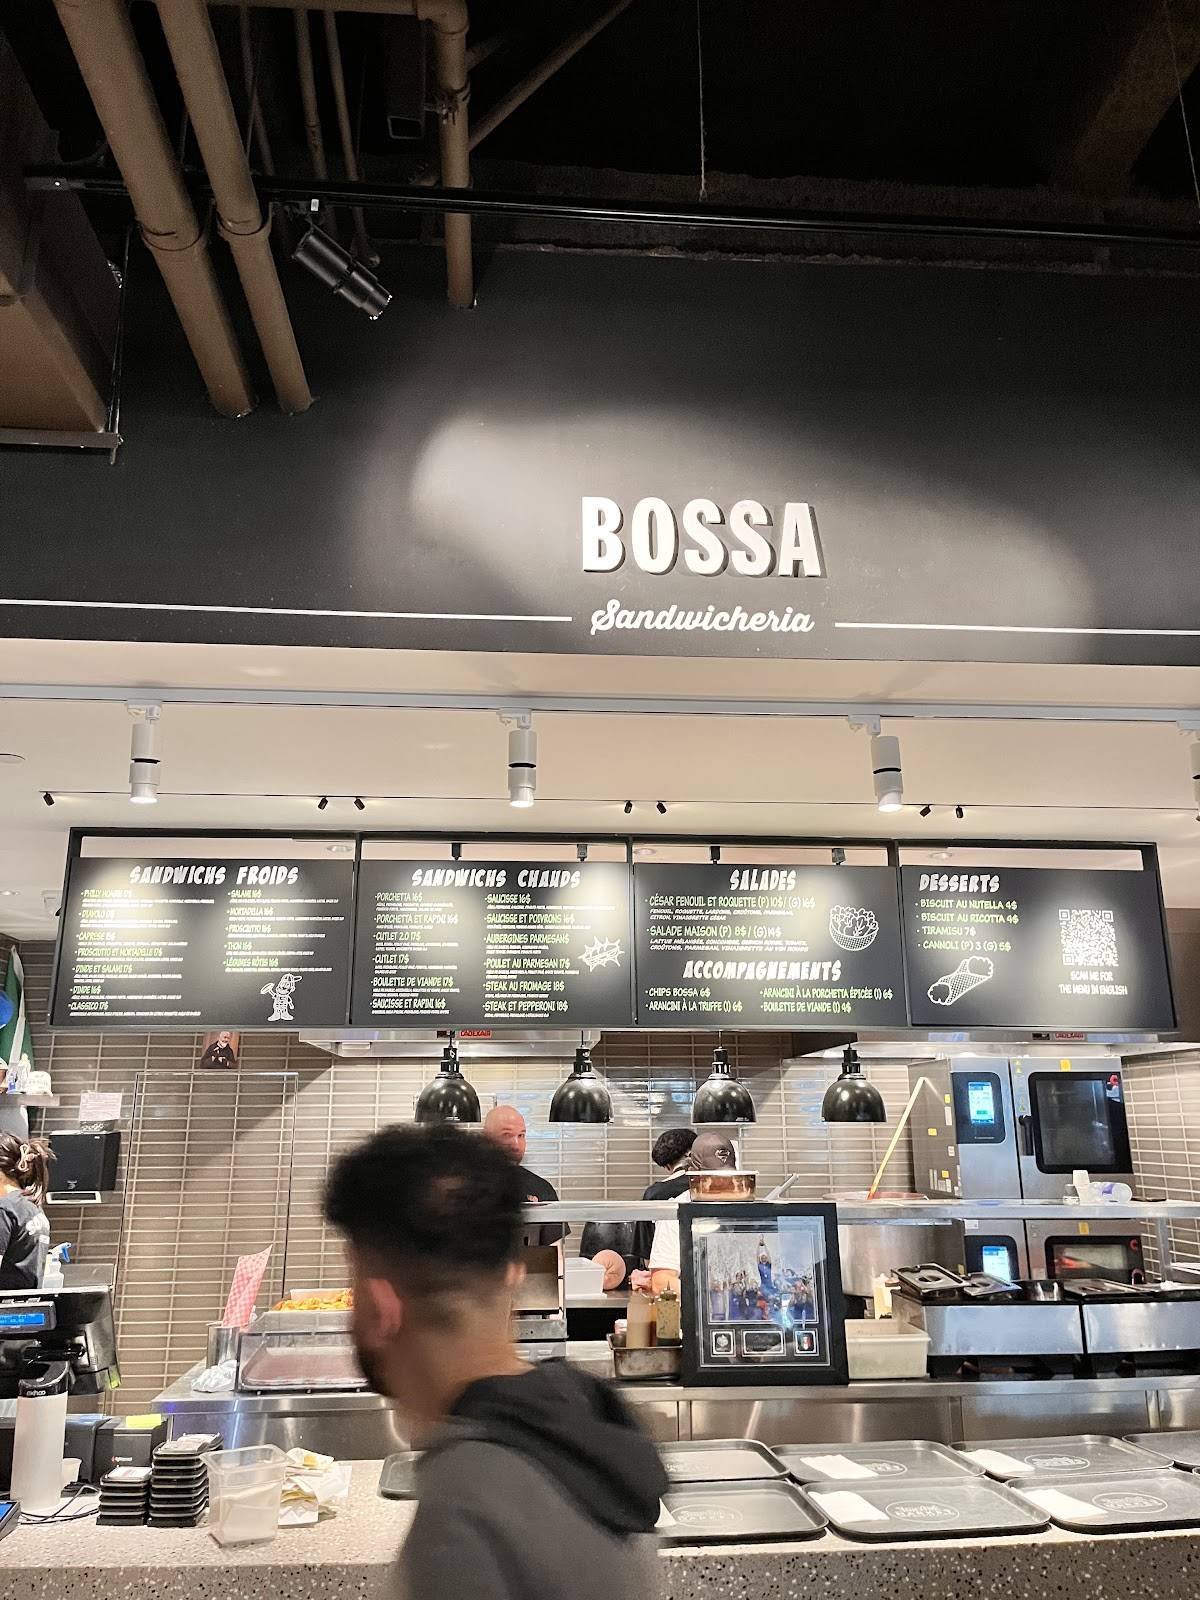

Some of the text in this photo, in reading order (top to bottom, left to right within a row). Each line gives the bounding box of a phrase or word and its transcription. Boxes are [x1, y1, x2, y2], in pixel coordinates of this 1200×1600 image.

[582, 496, 823, 578] BOSSA
[591, 598, 815, 635] Sandwicheria
[129, 865, 299, 885] SANDWICHS FROIDS
[411, 868, 581, 888] SANDWICHS CHAUDS
[729, 868, 797, 891] SALADES
[919, 873, 1000, 893] DESSERTS
[376, 892, 411, 902] PORCHETTA
[487, 893, 531, 904] SAUCISSE 16$
[649, 893, 675, 907] CÉSAR
[675, 896, 706, 907] FENOUIL
[707, 896, 718, 907] ET
[718, 896, 756, 908] ROQUETTE
[758, 896, 769, 909] (P)
[920, 899, 1018, 911] BISCUIT AU NUTELLA 4$
[376, 914, 413, 923] PORCHETTA
[413, 914, 423, 923] ET
[423, 914, 447, 924] RAPINI
[486, 913, 518, 923] SAUCISSE
[519, 914, 528, 923] ET
[529, 914, 562, 924] POIVRONS
[921, 912, 1019, 925] BISCUIT AU RICOTTA 4$
[376, 931, 398, 941] CUTLET
[650, 925, 683, 936] SALADE
[684, 925, 718, 937] MAISON
[719, 925, 732, 938] (P)
[921, 926, 977, 937] TIRAMISU 7$
[486, 933, 528, 943] AUBERGINES
[922, 940, 959, 950] CANNOLI
[960, 940, 974, 951] (P)
[983, 940, 998, 952] (G)
[374, 954, 409, 965] CUTLET 17$
[486, 958, 570, 969] POULET AU PARMESAN 17$
[75, 964, 93, 974] DINDE
[94, 965, 101, 974] ET
[102, 964, 124, 974] SALAMI
[682, 960, 842, 981] ACCOMPAGNEMENTS
[373, 976, 454, 987] BOULETTE DE VIANDE 17$
[1071, 970, 1113, 982] SCAN ME FOR
[73, 985, 91, 994] DINDE
[485, 981, 508, 991] STEAK
[509, 981, 518, 991] AU
[519, 981, 552, 991] FROMAGE
[1058, 983, 1072, 993] THE
[1091, 984, 1099, 995] IN
[1099, 984, 1128, 995] ENGLISH
[649, 987, 671, 997] CHIPS
[673, 987, 699, 997] BOSSA
[763, 987, 795, 998] ARANCINI
[796, 985, 802, 998] À
[802, 988, 812, 998] LA
[812, 987, 849, 999] PORCHETTA
[849, 986, 873, 999] ÉPICÉE
[71, 1001, 99, 1011] CLASSICO
[372, 998, 403, 1008] SAUCISSE
[404, 998, 413, 1008] ET
[413, 998, 434, 1009] RAPINI
[485, 1001, 507, 1011] STEAK
[508, 1001, 517, 1011] ET
[518, 1001, 556, 1011] PEPPERONI
[649, 1001, 681, 1011] ARANCINI
[681, 998, 688, 1011] À
[688, 1001, 698, 1011] LA
[698, 1001, 723, 1011] TRUFFE
[763, 1002, 796, 1012] BOULETTE
[796, 1002, 806, 1012] DE
[806, 1002, 832, 1012] VIANDE
